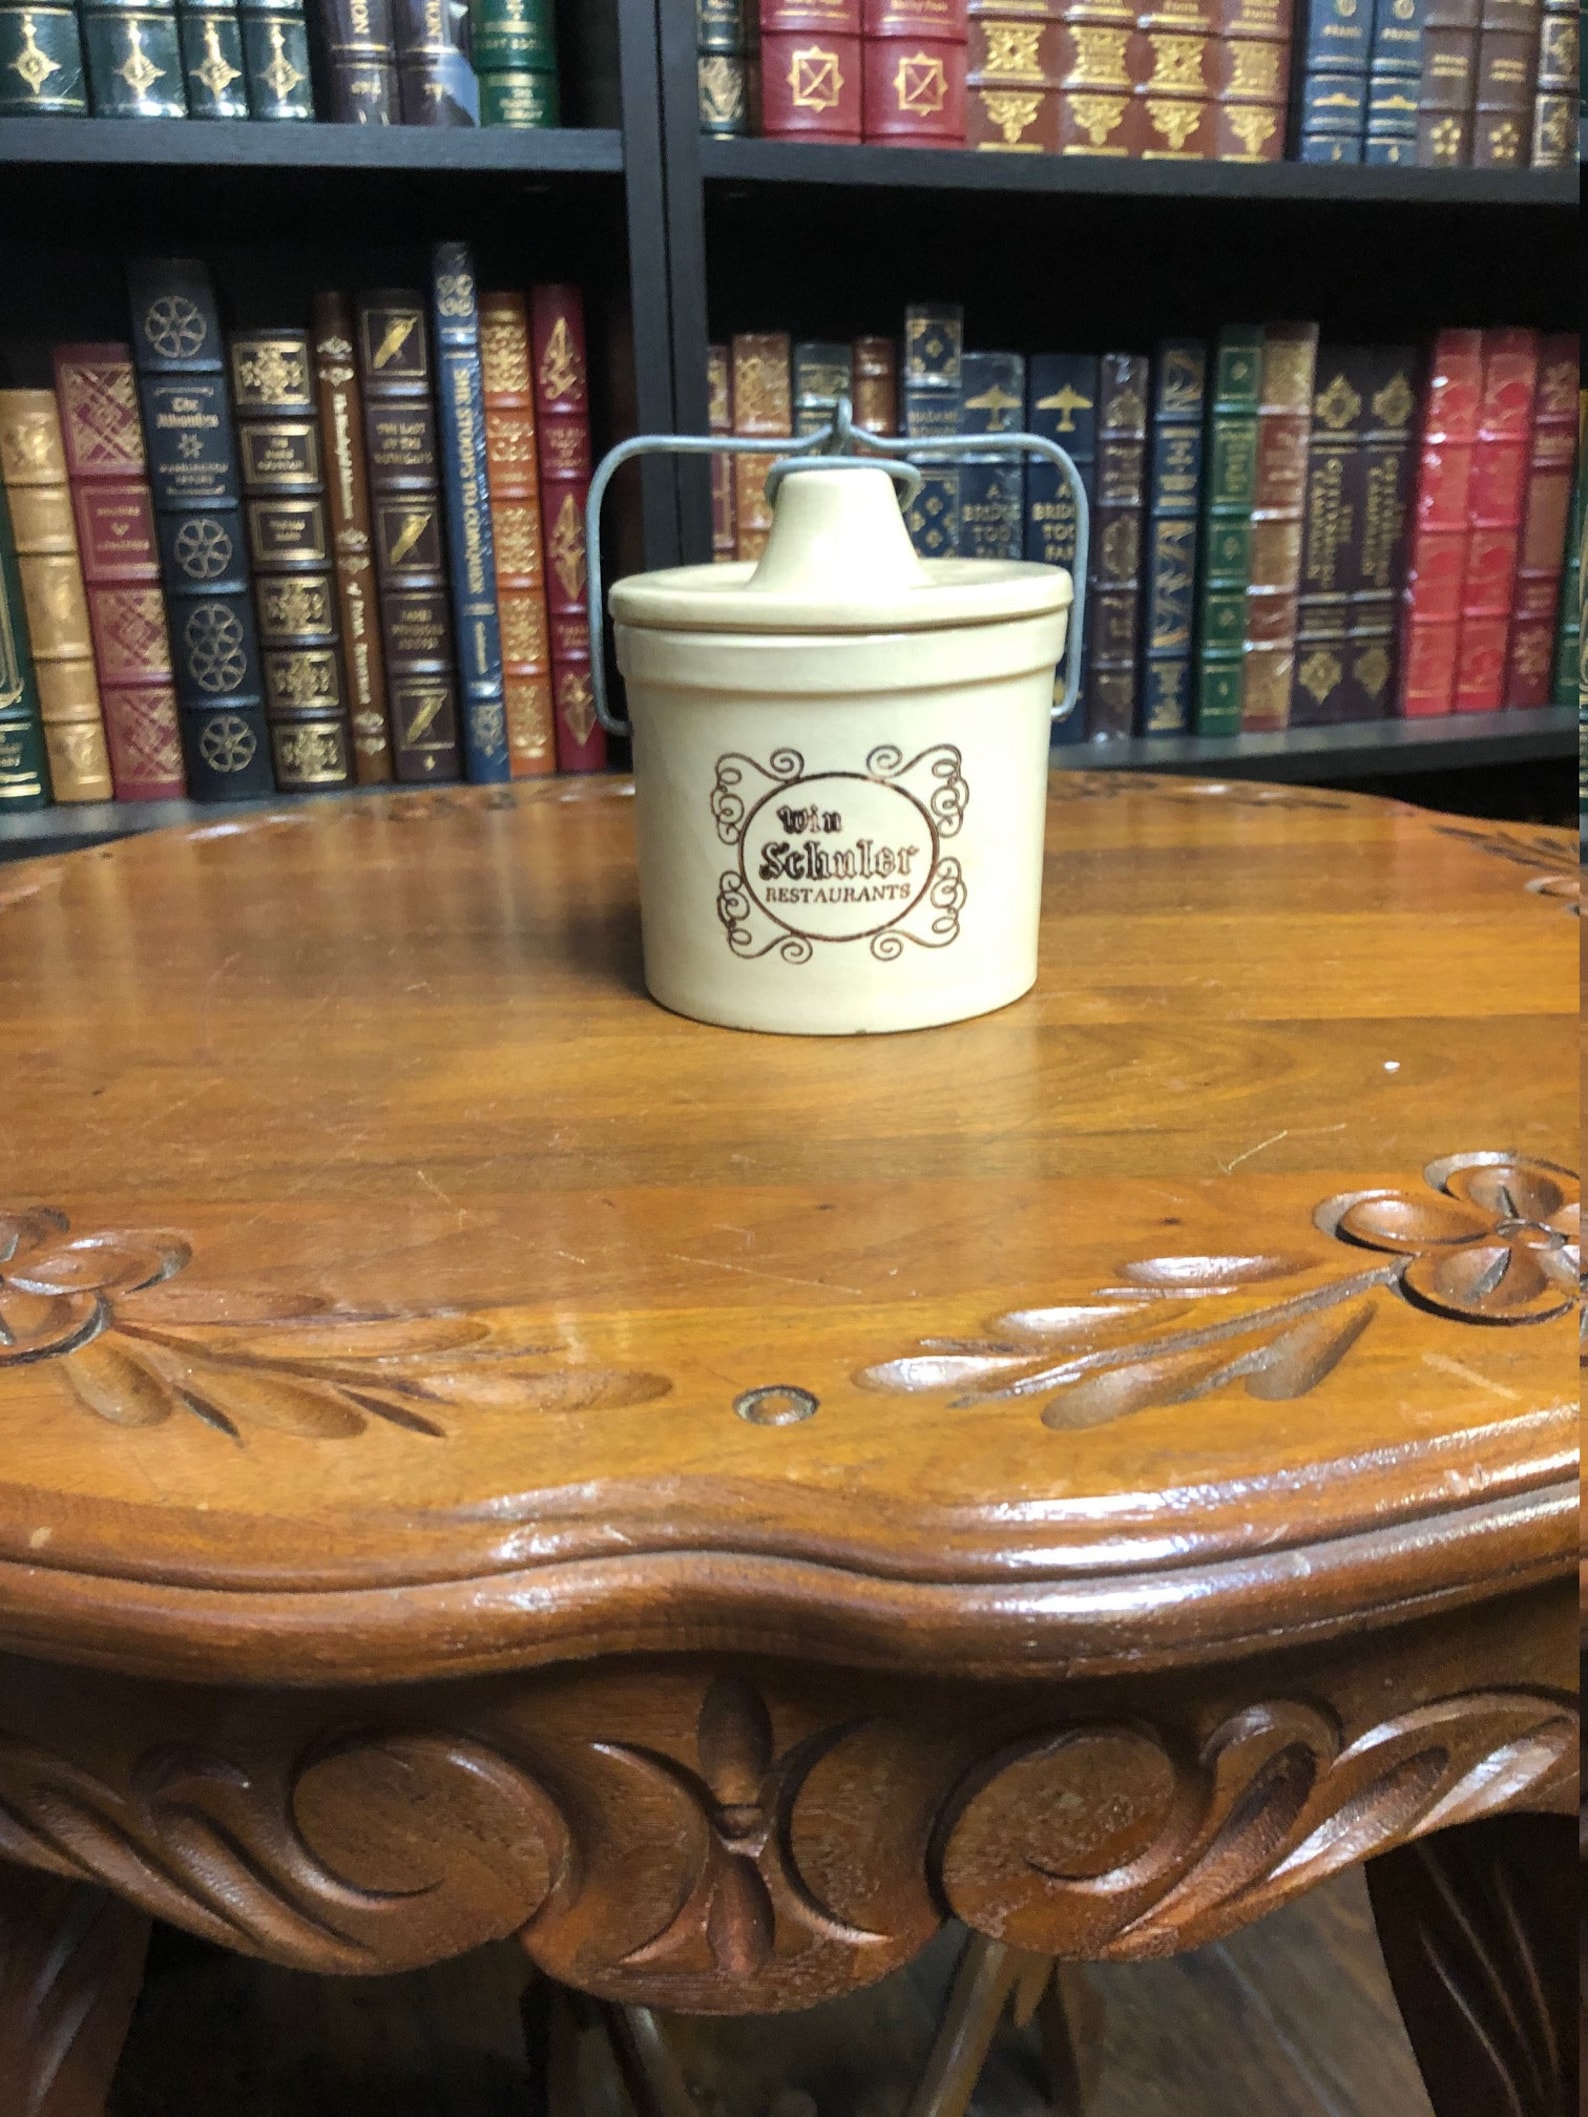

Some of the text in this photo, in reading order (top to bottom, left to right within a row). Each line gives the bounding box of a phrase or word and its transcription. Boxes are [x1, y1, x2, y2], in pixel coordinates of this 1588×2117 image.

[1032, 503, 1075, 520] BRID
[776, 804, 843, 834] Win
[759, 840, 919, 881] Schuler
[766, 883, 911, 904] RESTAURANTS
